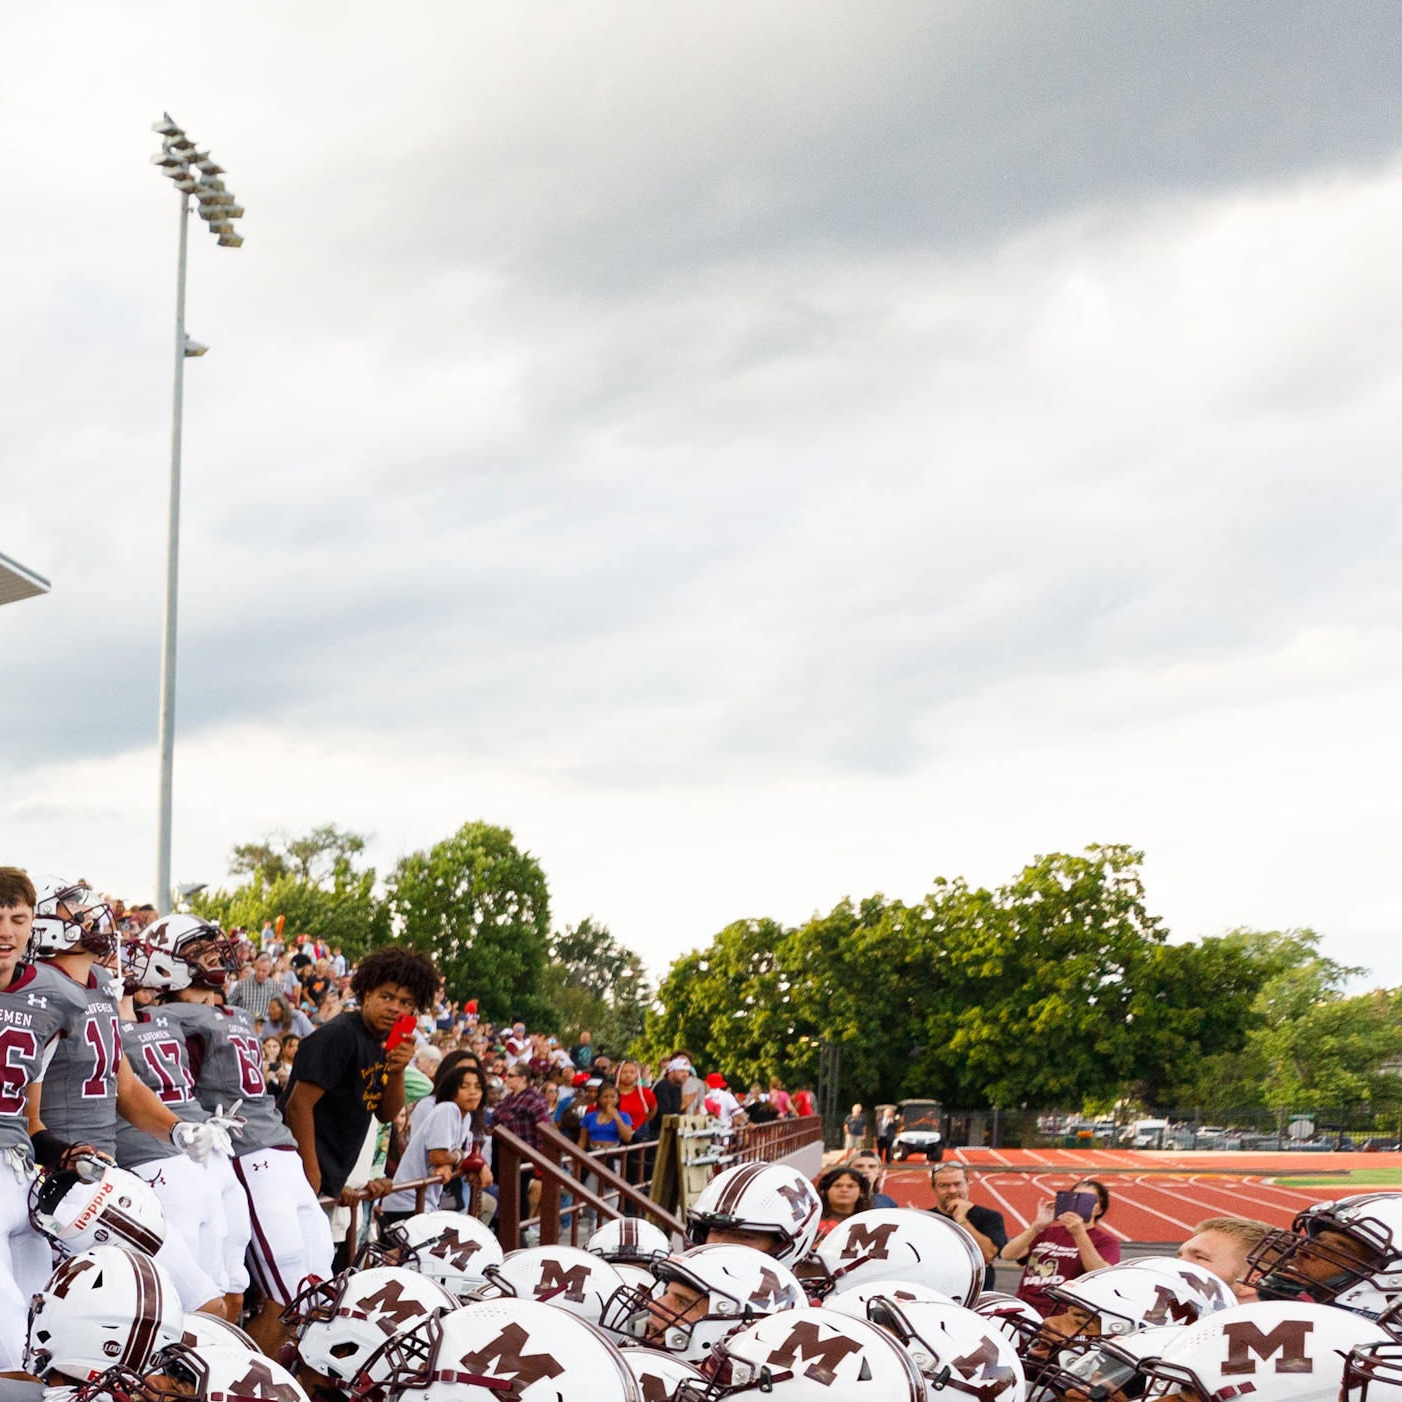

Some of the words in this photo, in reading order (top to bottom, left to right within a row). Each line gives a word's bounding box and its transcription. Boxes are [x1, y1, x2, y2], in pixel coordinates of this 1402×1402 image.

[143, 1039, 195, 1104] 17
[74, 1182, 115, 1231] Riddell
[777, 1177, 813, 1221] M
[430, 1227, 482, 1272] M
[840, 1223, 899, 1259] M
[534, 1259, 591, 1304] M
[748, 1266, 796, 1312] M
[1143, 1284, 1202, 1324] M
[357, 1280, 427, 1336] M
[766, 1320, 864, 1386] M
[1221, 1320, 1314, 1376] M
